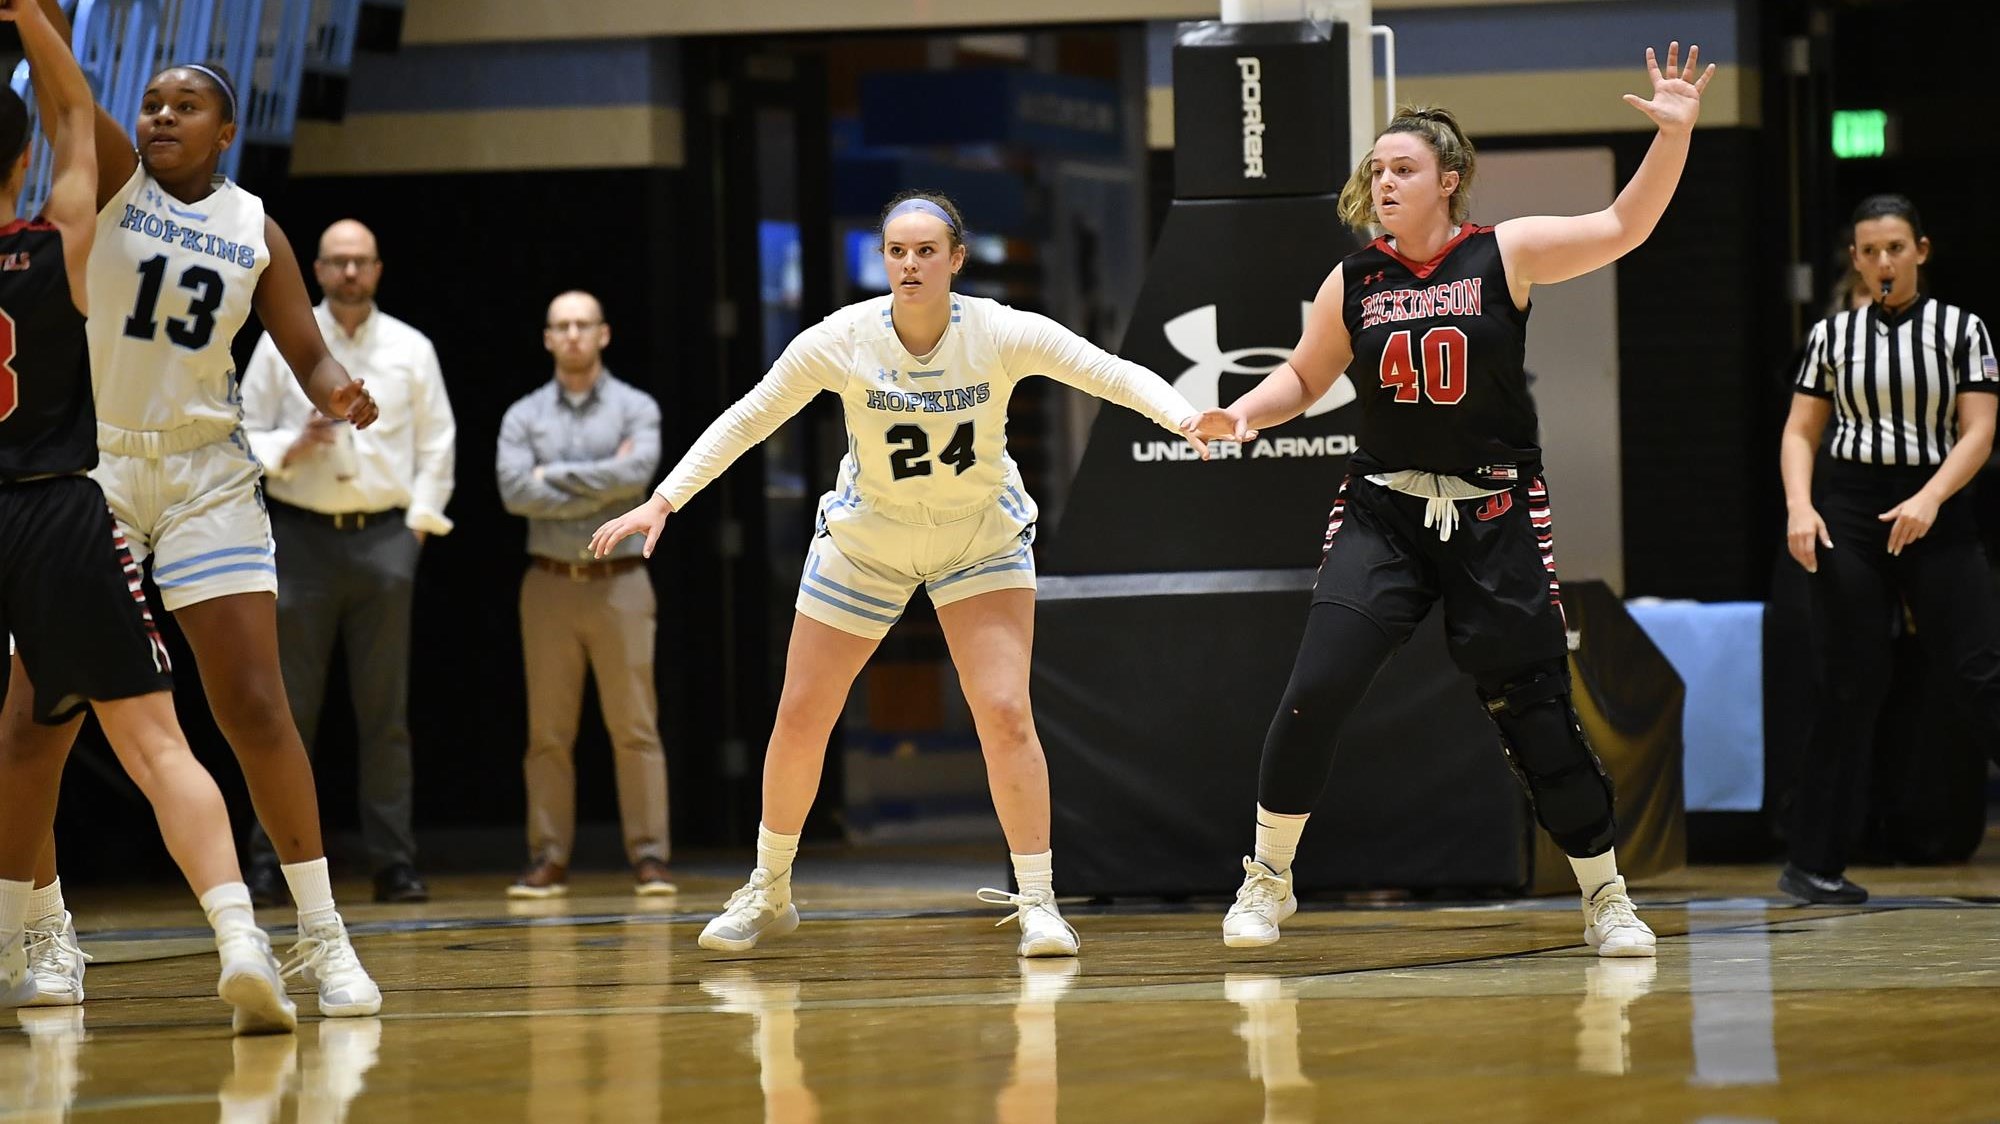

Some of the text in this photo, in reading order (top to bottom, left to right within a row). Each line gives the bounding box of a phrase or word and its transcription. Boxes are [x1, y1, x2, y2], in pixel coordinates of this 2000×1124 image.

[120, 204, 256, 269] HOPKINS
[123, 252, 225, 351] 13
[1361, 277, 1482, 329] DICKINSON
[1379, 326, 1468, 405] 40
[865, 381, 991, 413] HOPKINS
[885, 419, 976, 481] 24
[1132, 440, 1242, 462] UNDER
